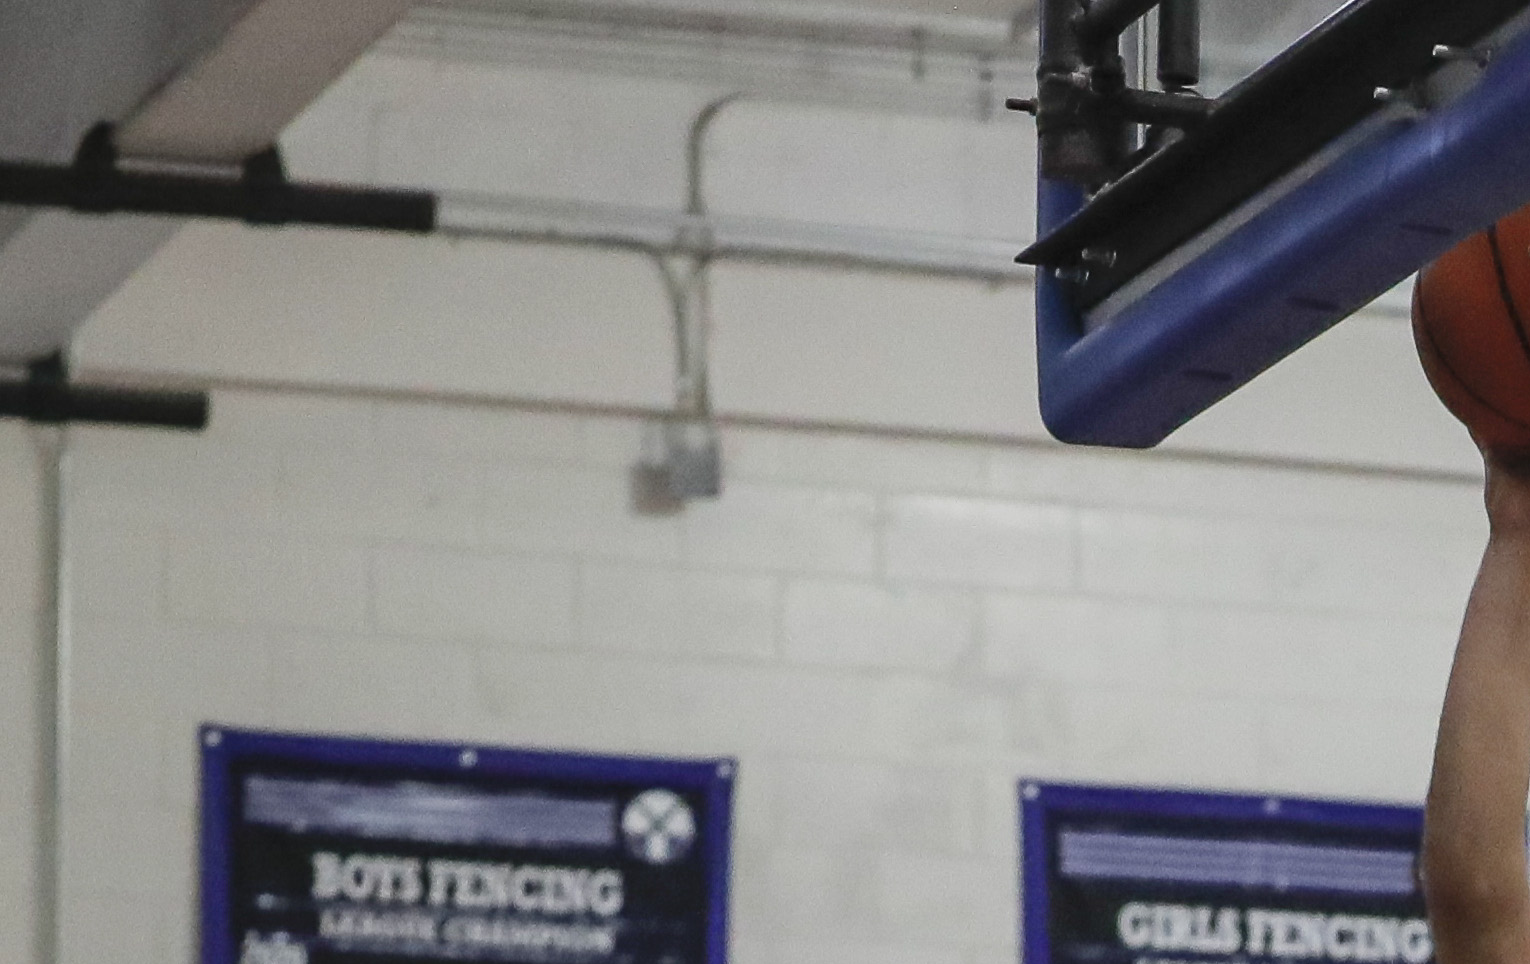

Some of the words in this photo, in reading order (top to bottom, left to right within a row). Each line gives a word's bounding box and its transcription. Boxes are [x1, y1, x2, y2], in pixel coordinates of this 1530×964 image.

[313, 853, 422, 902] BOYS
[426, 860, 623, 916] FENCING
[1117, 902, 1243, 955] GIRLS
[1246, 909, 1433, 964] FENCING
